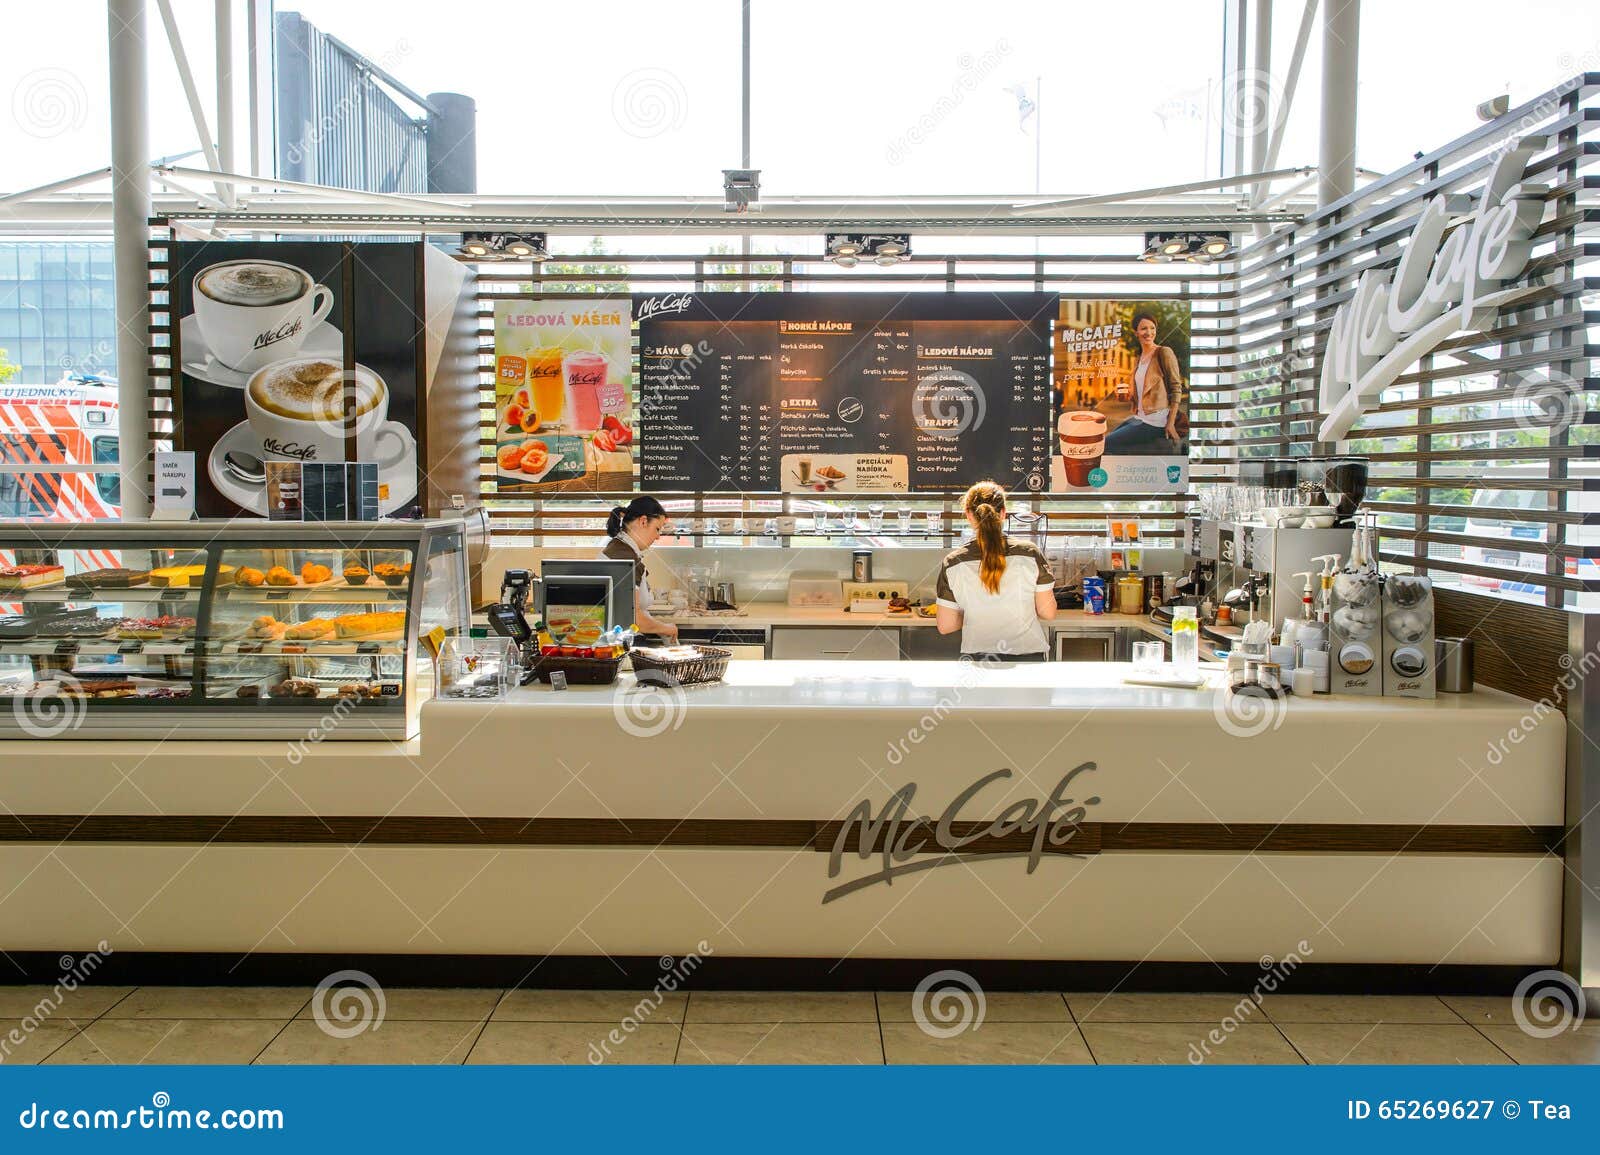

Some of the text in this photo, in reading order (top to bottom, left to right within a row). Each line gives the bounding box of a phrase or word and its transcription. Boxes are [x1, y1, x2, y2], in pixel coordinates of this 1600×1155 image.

[637, 293, 692, 321] McCafé
[507, 311, 621, 327] LEDOVÁ VÁŠEŇ
[788, 321, 852, 331] HORKÉ NÁPOJE
[254, 315, 303, 350] McCafé
[1062, 320, 1122, 343] McCAFÉ
[656, 346, 680, 355] KÁVA
[924, 346, 993, 356] LEDOVÉ NÁPOJE
[1067, 340, 1118, 353] KEEPCUP
[924, 418, 959, 426] FRAPPÉ
[263, 438, 317, 460] McCafé
[821, 762, 1101, 905] McCafé
